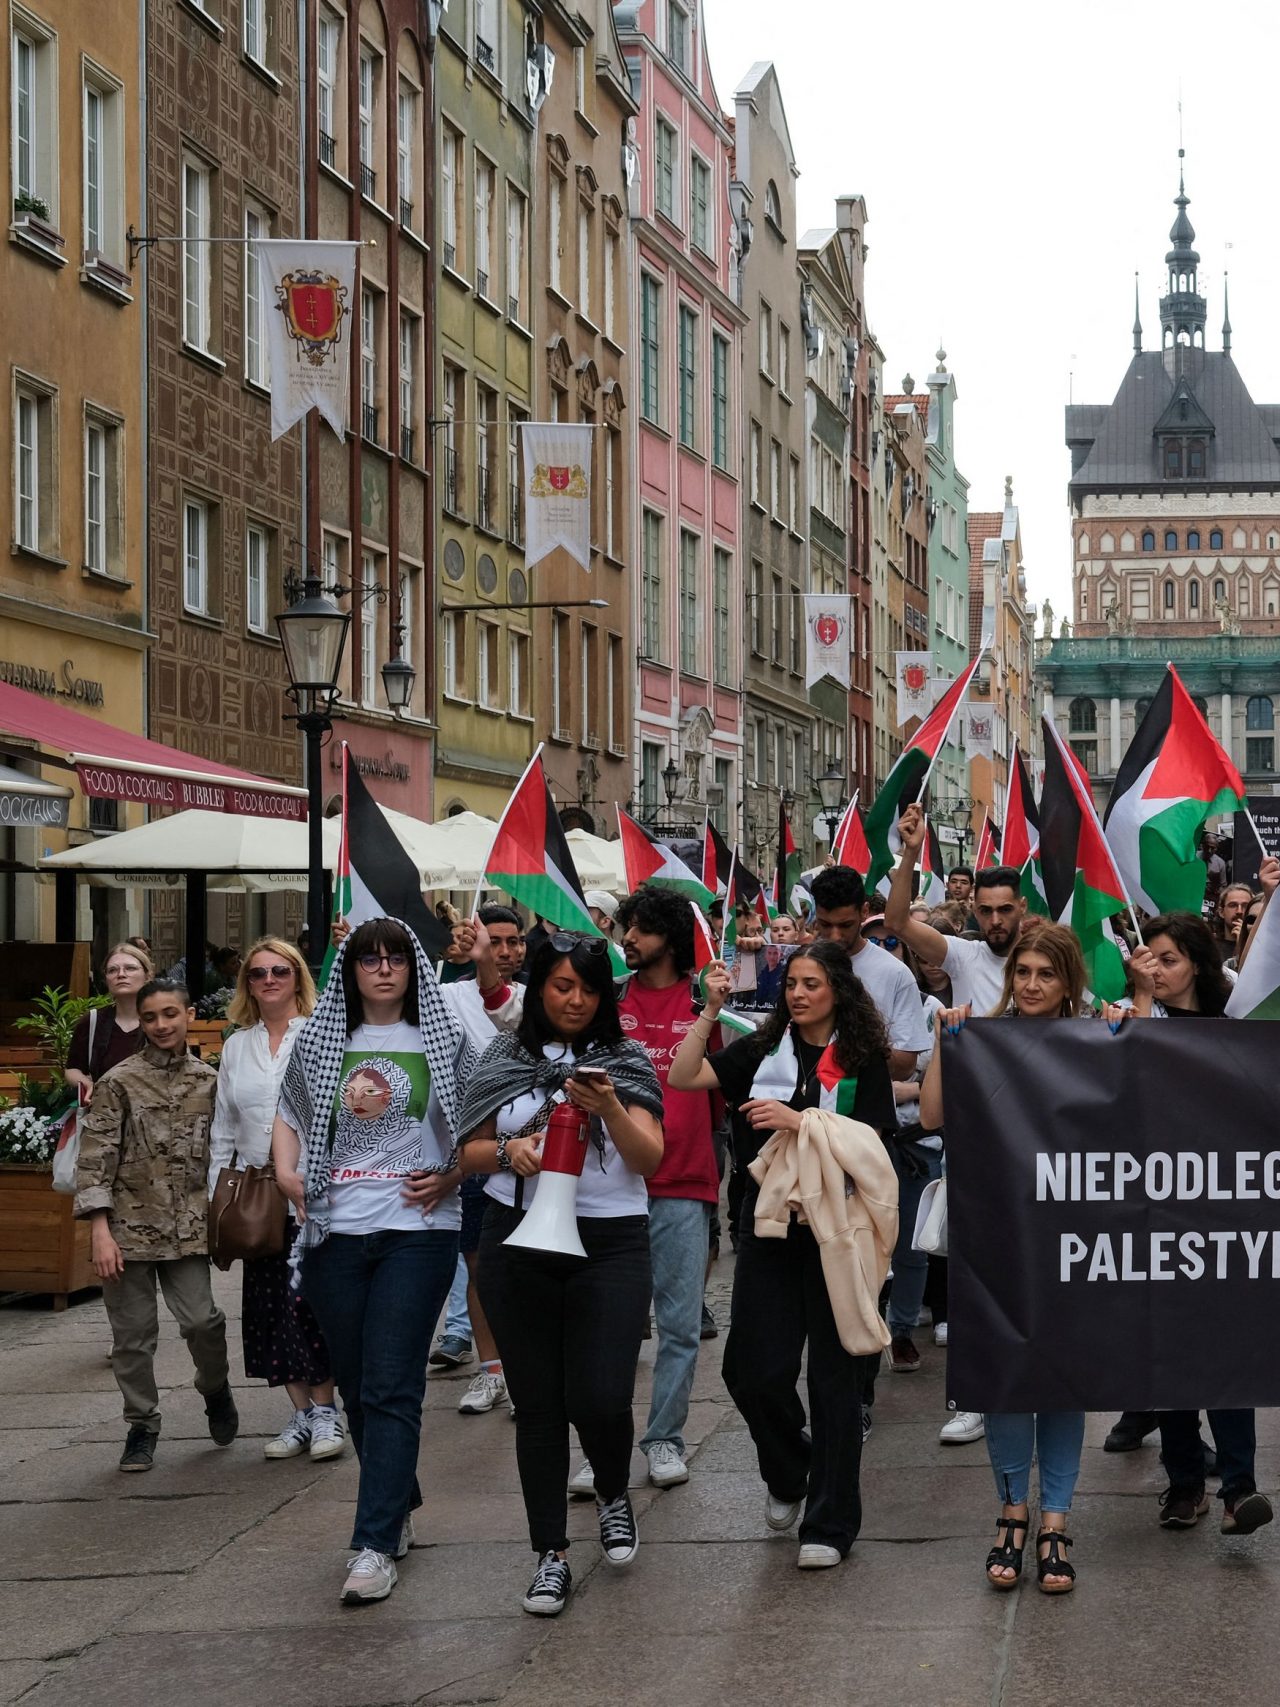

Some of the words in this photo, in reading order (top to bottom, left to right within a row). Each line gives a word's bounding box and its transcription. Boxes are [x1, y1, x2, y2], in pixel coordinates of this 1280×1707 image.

[84, 769, 116, 793] FOOD
[125, 776, 174, 801] COCKTAILS
[182, 783, 225, 808] BUBBLES
[234, 791, 258, 812] FOOD
[263, 796, 301, 817] COCKTAILS
[0, 795, 62, 823] OCKTAILS
[1260, 815, 1279, 823] there
[268, 873, 308, 883] CUKIERN
